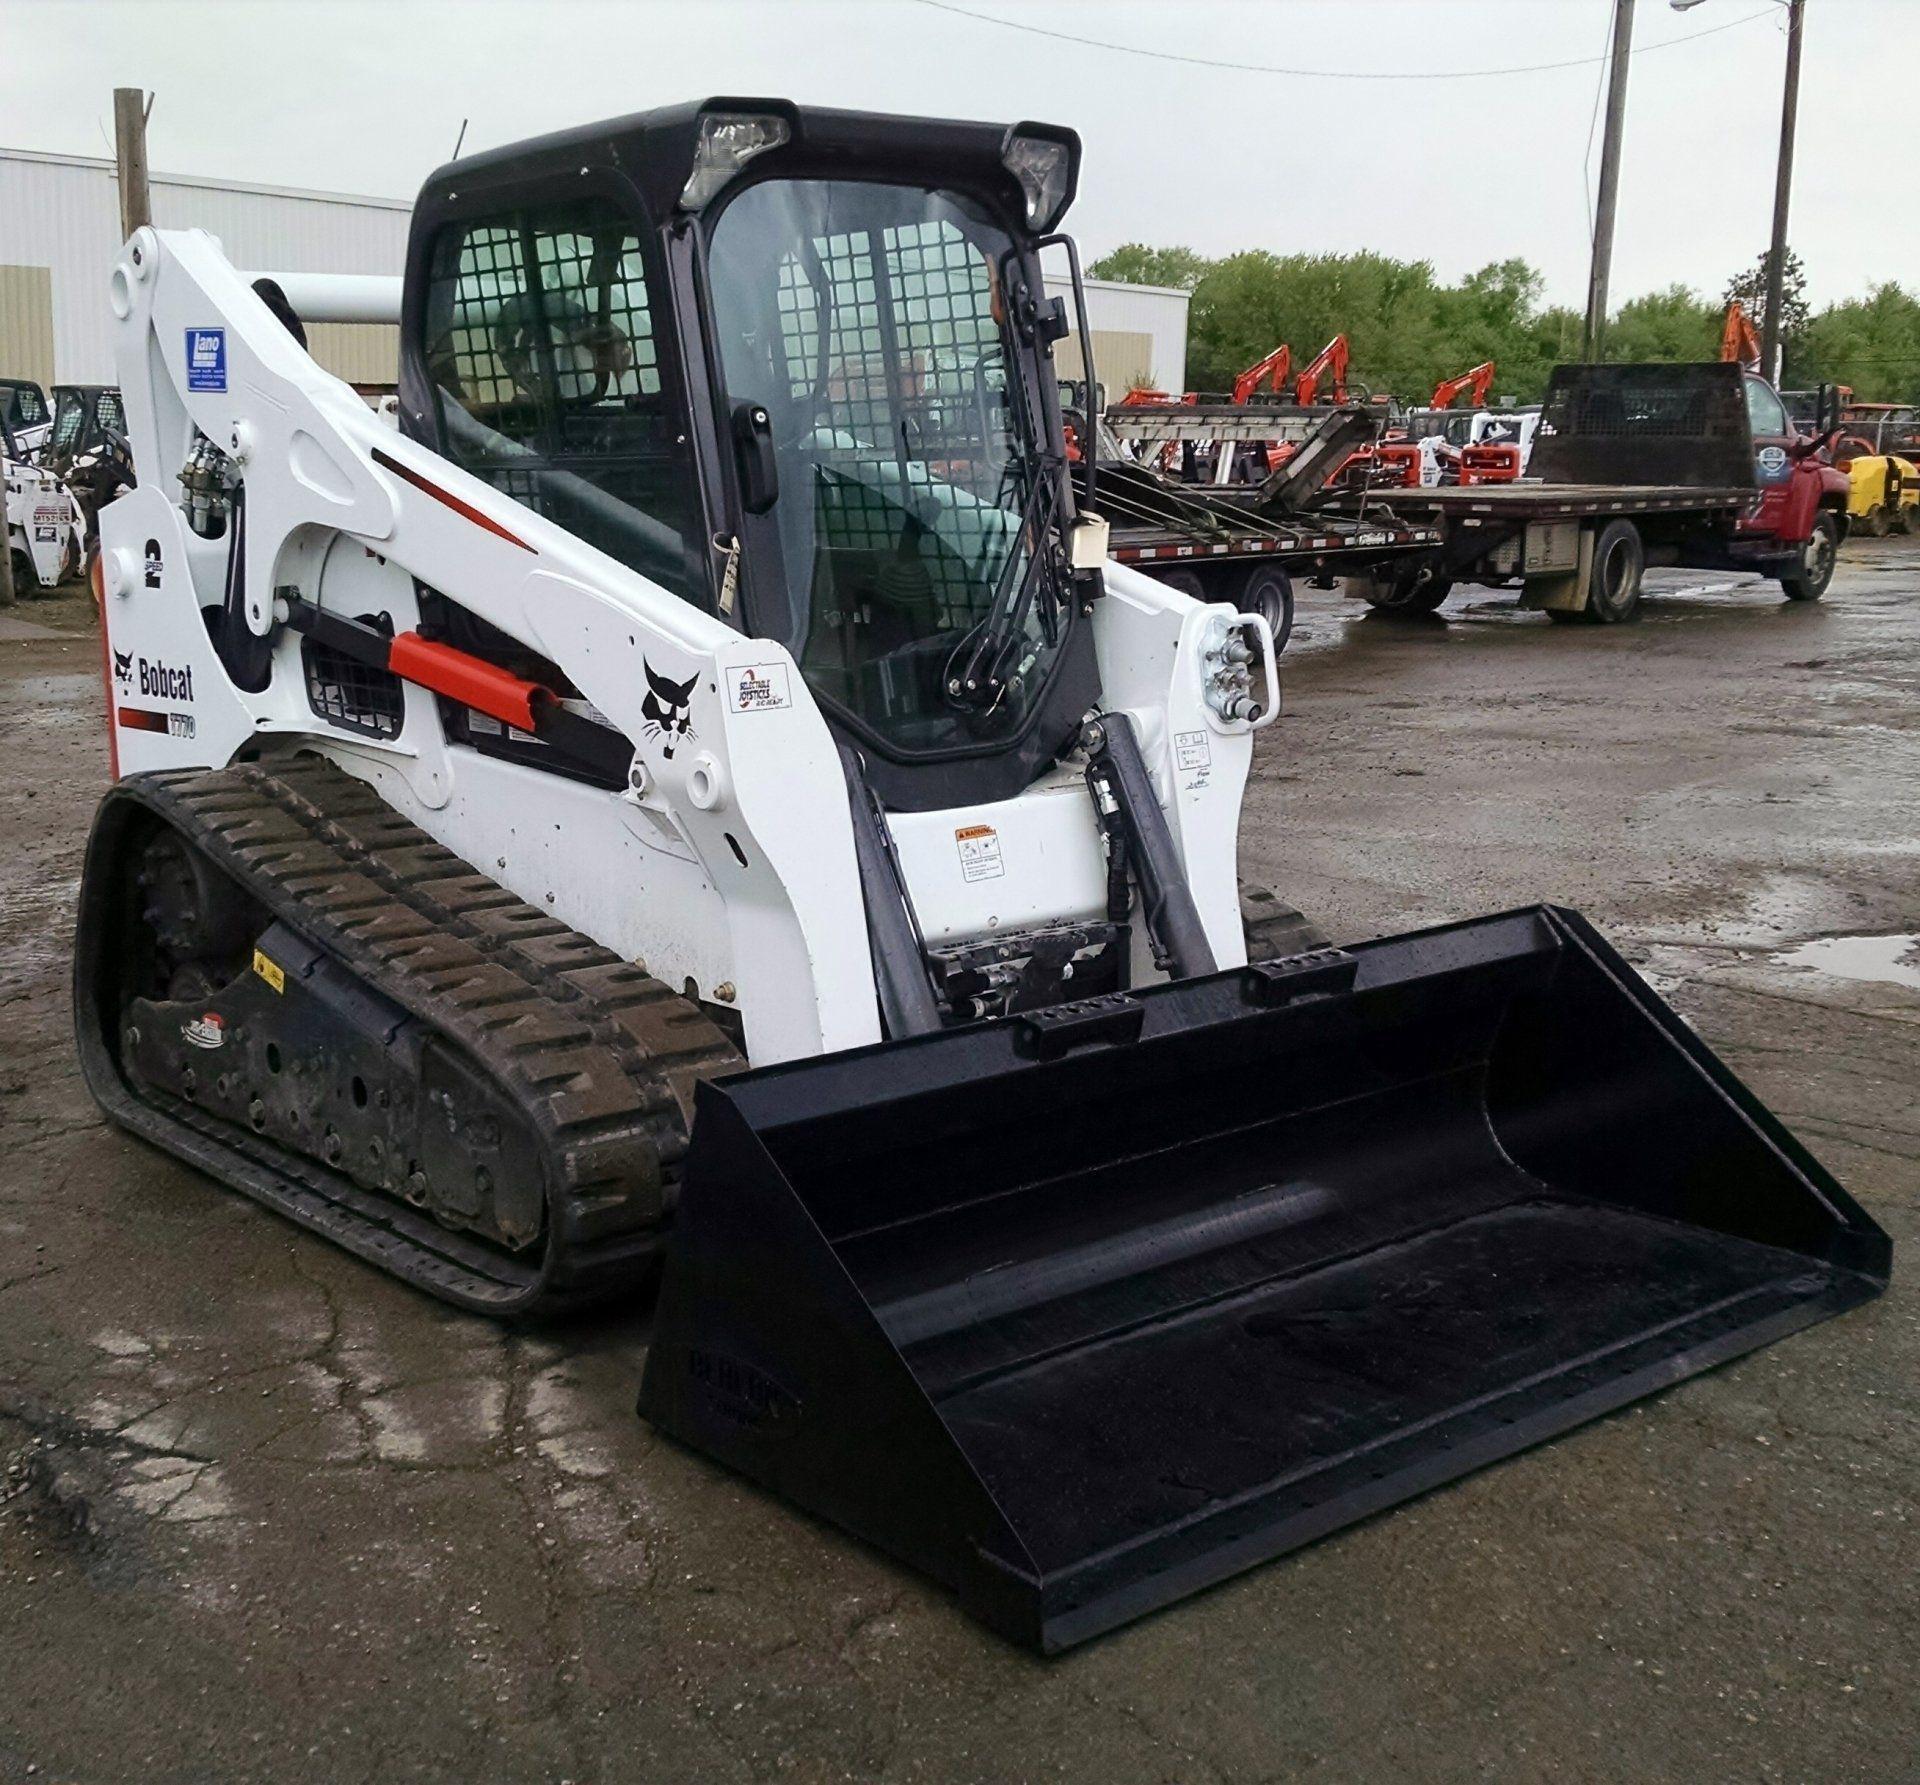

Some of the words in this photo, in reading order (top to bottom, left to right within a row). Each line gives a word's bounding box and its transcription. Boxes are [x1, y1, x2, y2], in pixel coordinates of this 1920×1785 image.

[138, 657, 194, 702] Bobcat
[739, 688, 770, 701] JOYSTICKS
[169, 712, 196, 739] T770
[965, 827, 993, 837] WARNING
